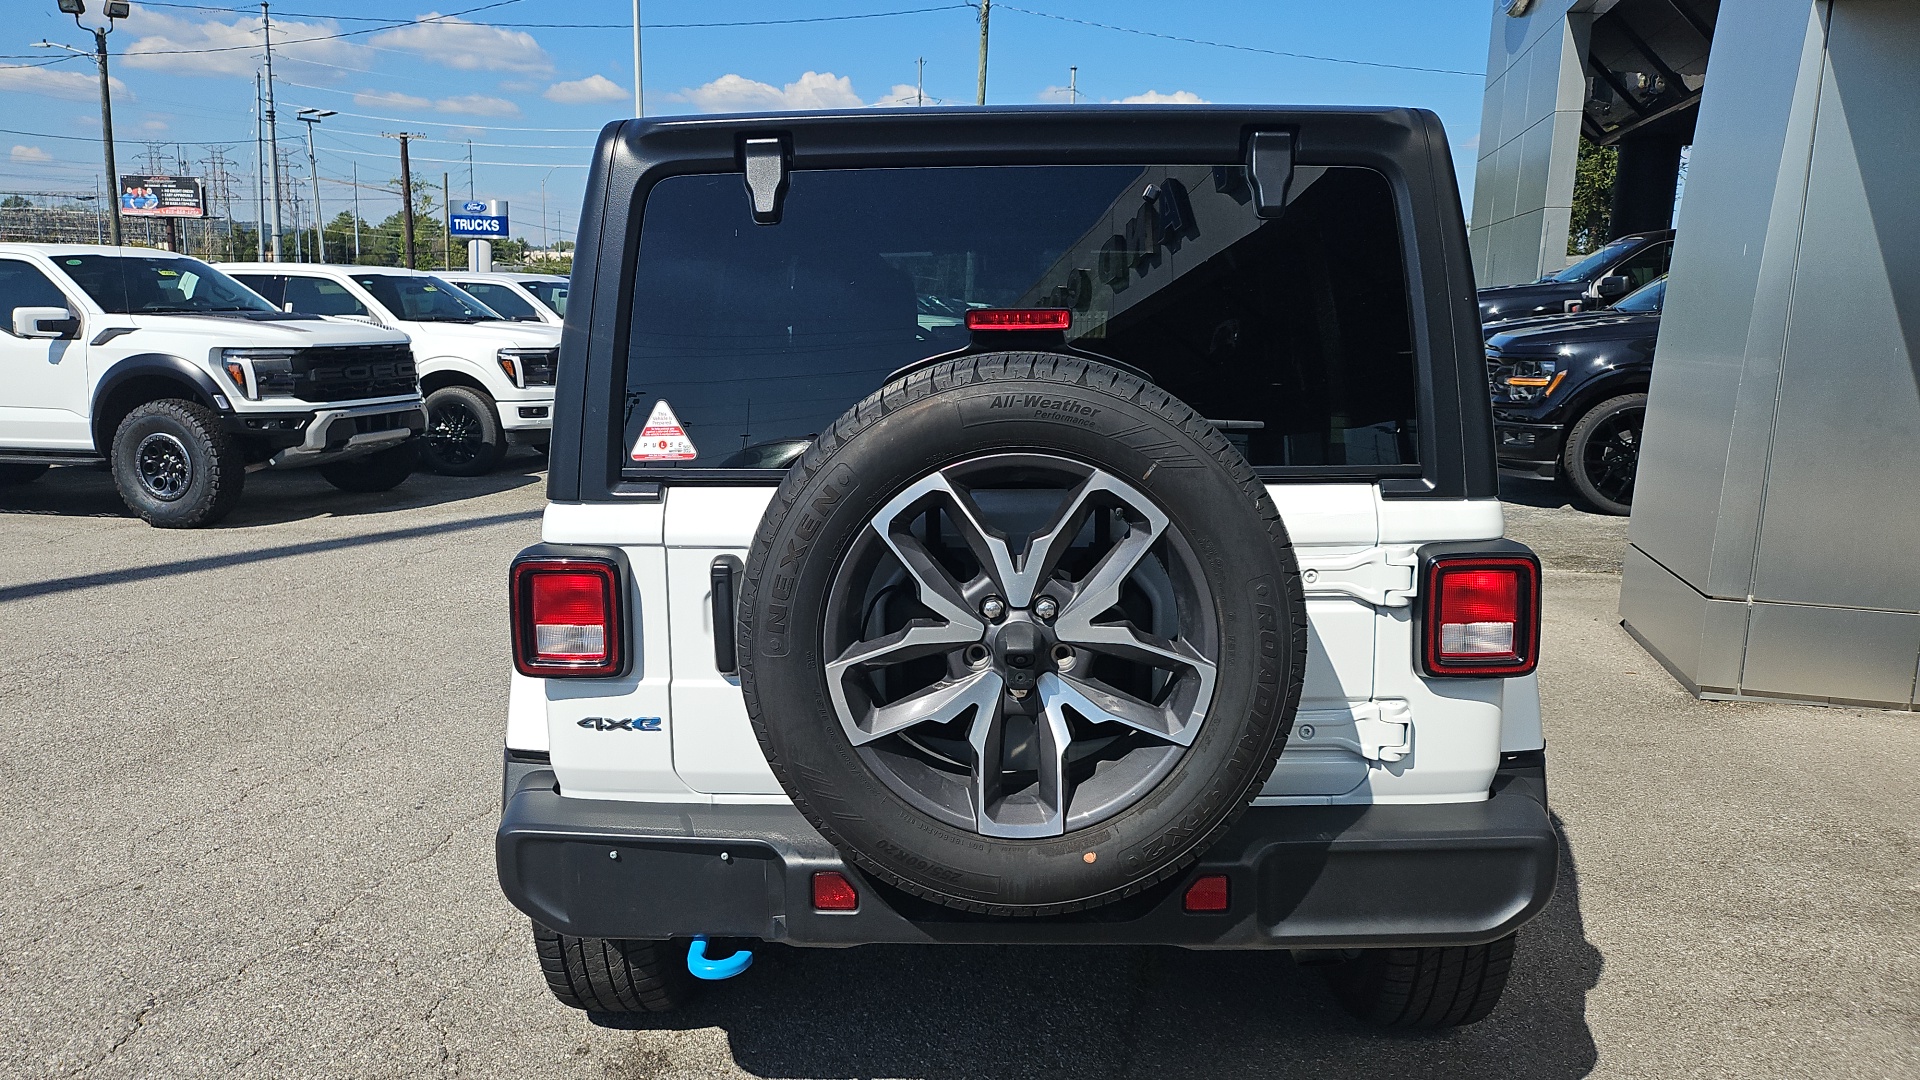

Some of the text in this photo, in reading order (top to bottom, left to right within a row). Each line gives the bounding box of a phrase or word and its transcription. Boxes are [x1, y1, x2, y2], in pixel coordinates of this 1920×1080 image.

[454, 218, 500, 232] TRUCKS
[989, 394, 1102, 419] All-Weather
[1033, 409, 1096, 428] Performance
[767, 484, 843, 635] NEXEN
[1225, 603, 1278, 778] ROADIAN
[875, 838, 963, 884] 255/60R20
